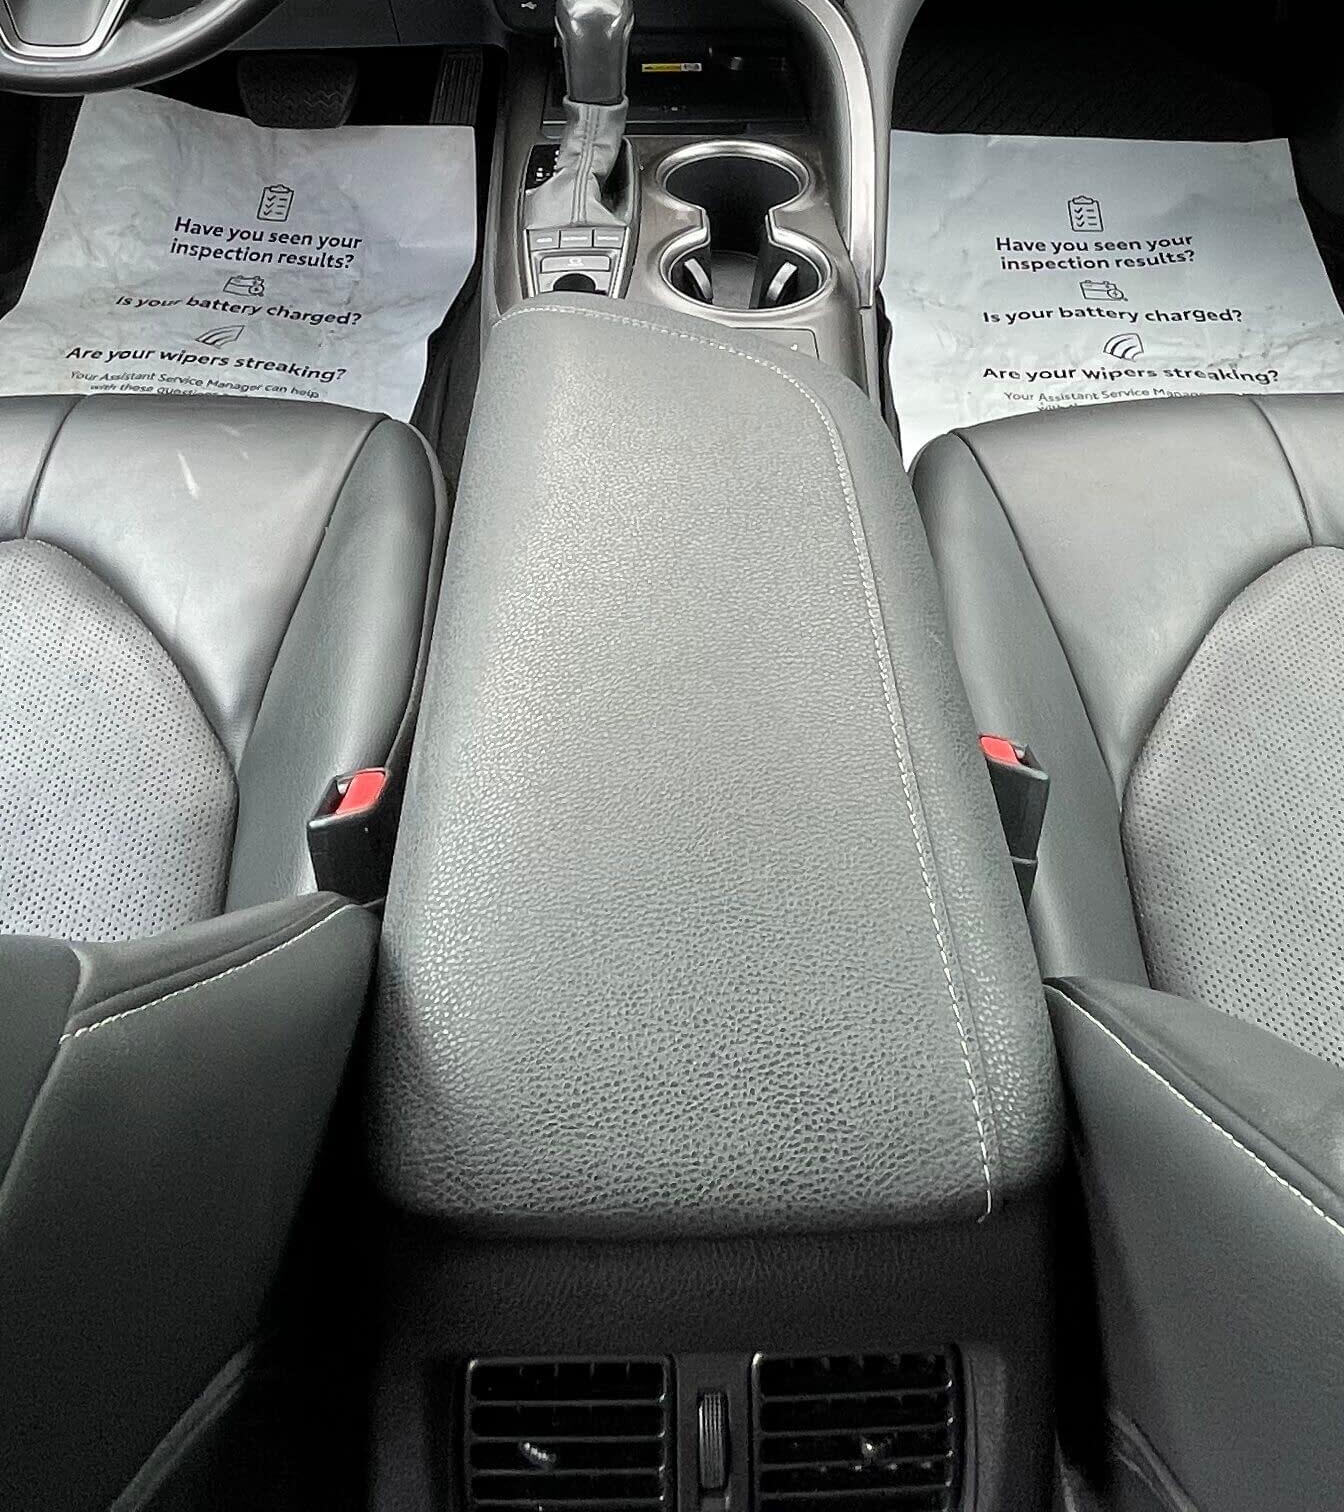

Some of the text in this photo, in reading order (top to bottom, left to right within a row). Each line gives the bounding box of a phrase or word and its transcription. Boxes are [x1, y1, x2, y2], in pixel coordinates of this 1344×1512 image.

[175, 216, 363, 251] Have you seen your
[996, 235, 1193, 254] Have you seen your
[170, 237, 354, 269] inspection results?
[1001, 249, 1195, 273] inspection results?
[116, 295, 363, 326] Is your battery charged?
[983, 306, 1243, 325] Is your battery charged?
[66, 347, 347, 383] Are your wipers streaking?
[983, 366, 1279, 384] Are your wipers streaking?
[70, 371, 320, 399] Your Assistant Service Manager can help
[1004, 391, 1034, 401] Your
[1038, 391, 1099, 402] Assistant
[1101, 388, 1150, 399] Service
